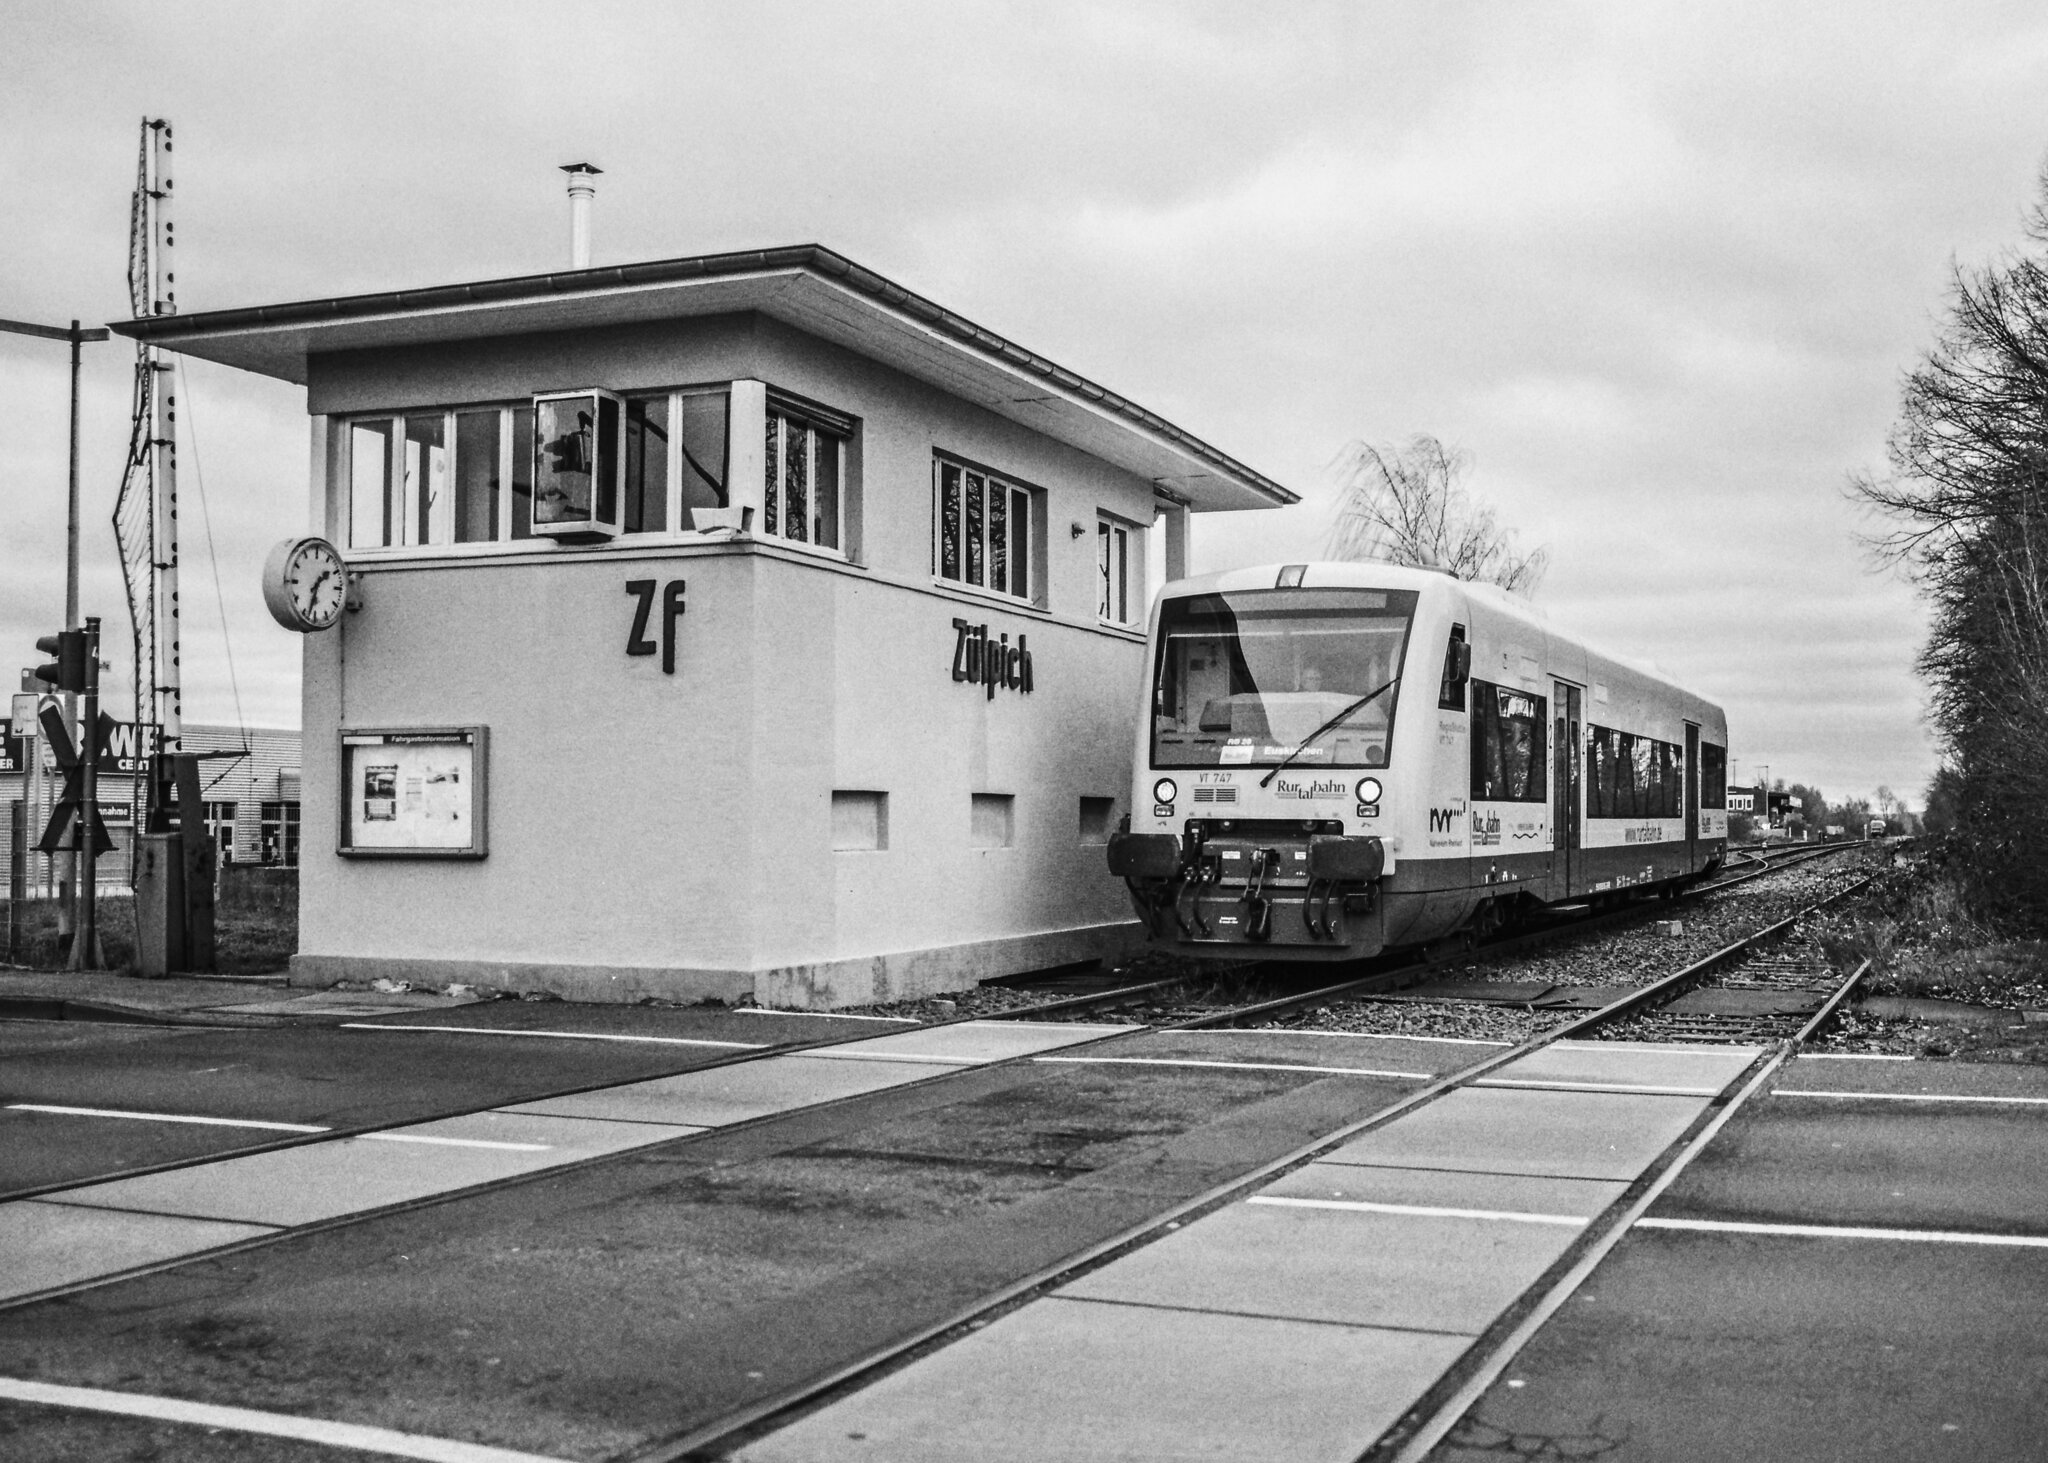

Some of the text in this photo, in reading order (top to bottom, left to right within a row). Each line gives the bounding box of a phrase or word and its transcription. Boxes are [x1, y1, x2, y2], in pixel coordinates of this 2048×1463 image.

[626, 580, 686, 674] Zf
[951, 617, 1034, 700] Zülpich
[1199, 773, 1233, 783] VT 747
